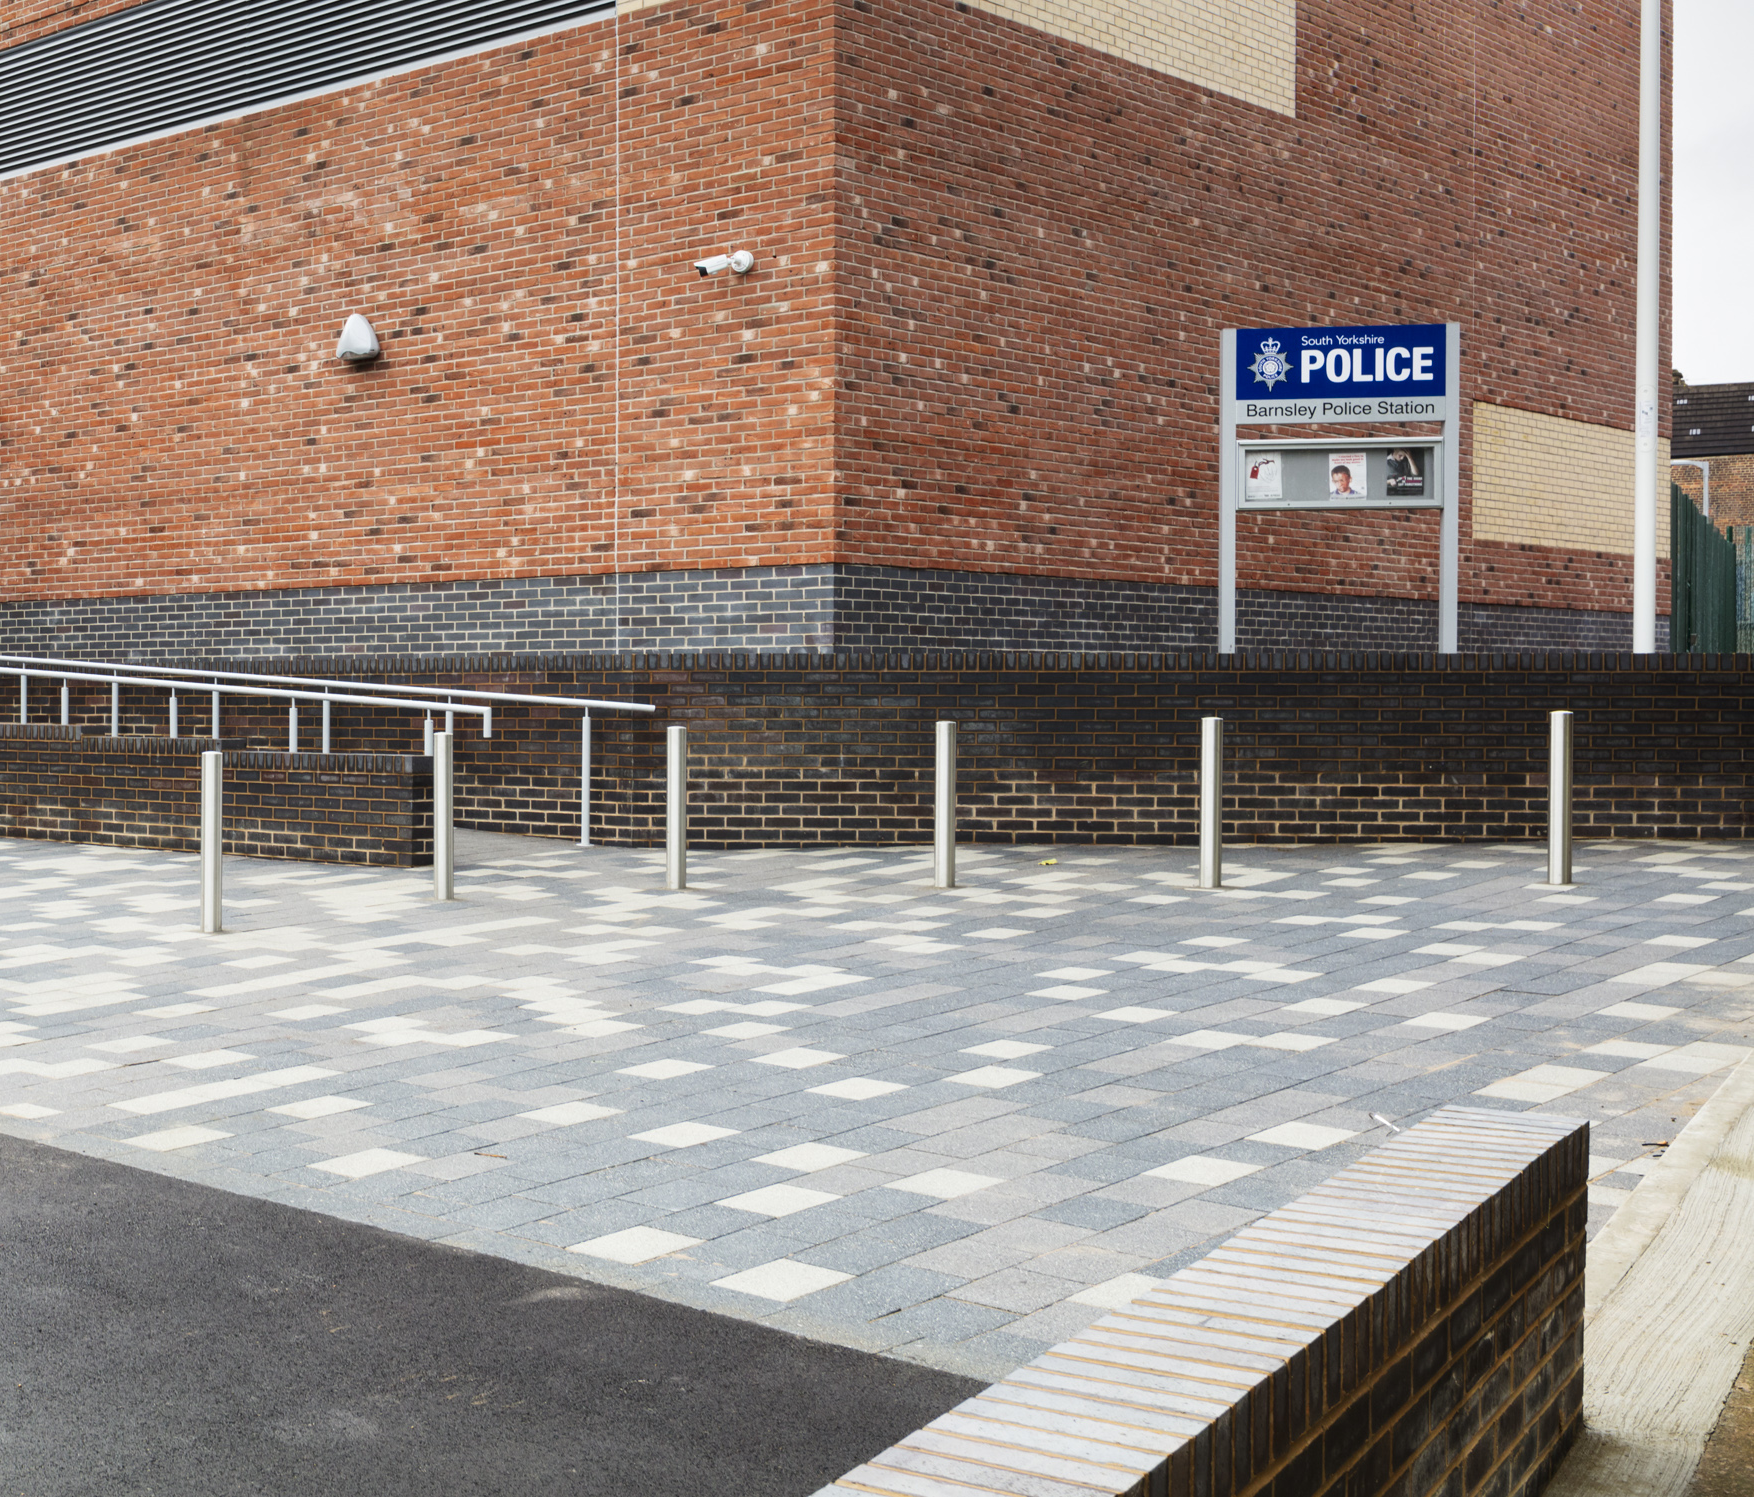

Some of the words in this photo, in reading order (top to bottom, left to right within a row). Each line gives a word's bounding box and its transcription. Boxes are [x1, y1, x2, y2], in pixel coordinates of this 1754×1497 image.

[1301, 335, 1333, 346] South
[1336, 334, 1385, 345] Yorkshire
[1300, 346, 1434, 383] POLICE
[1246, 403, 1317, 420] Barnsley
[1322, 402, 1372, 415] Police
[1377, 400, 1435, 415] Station
